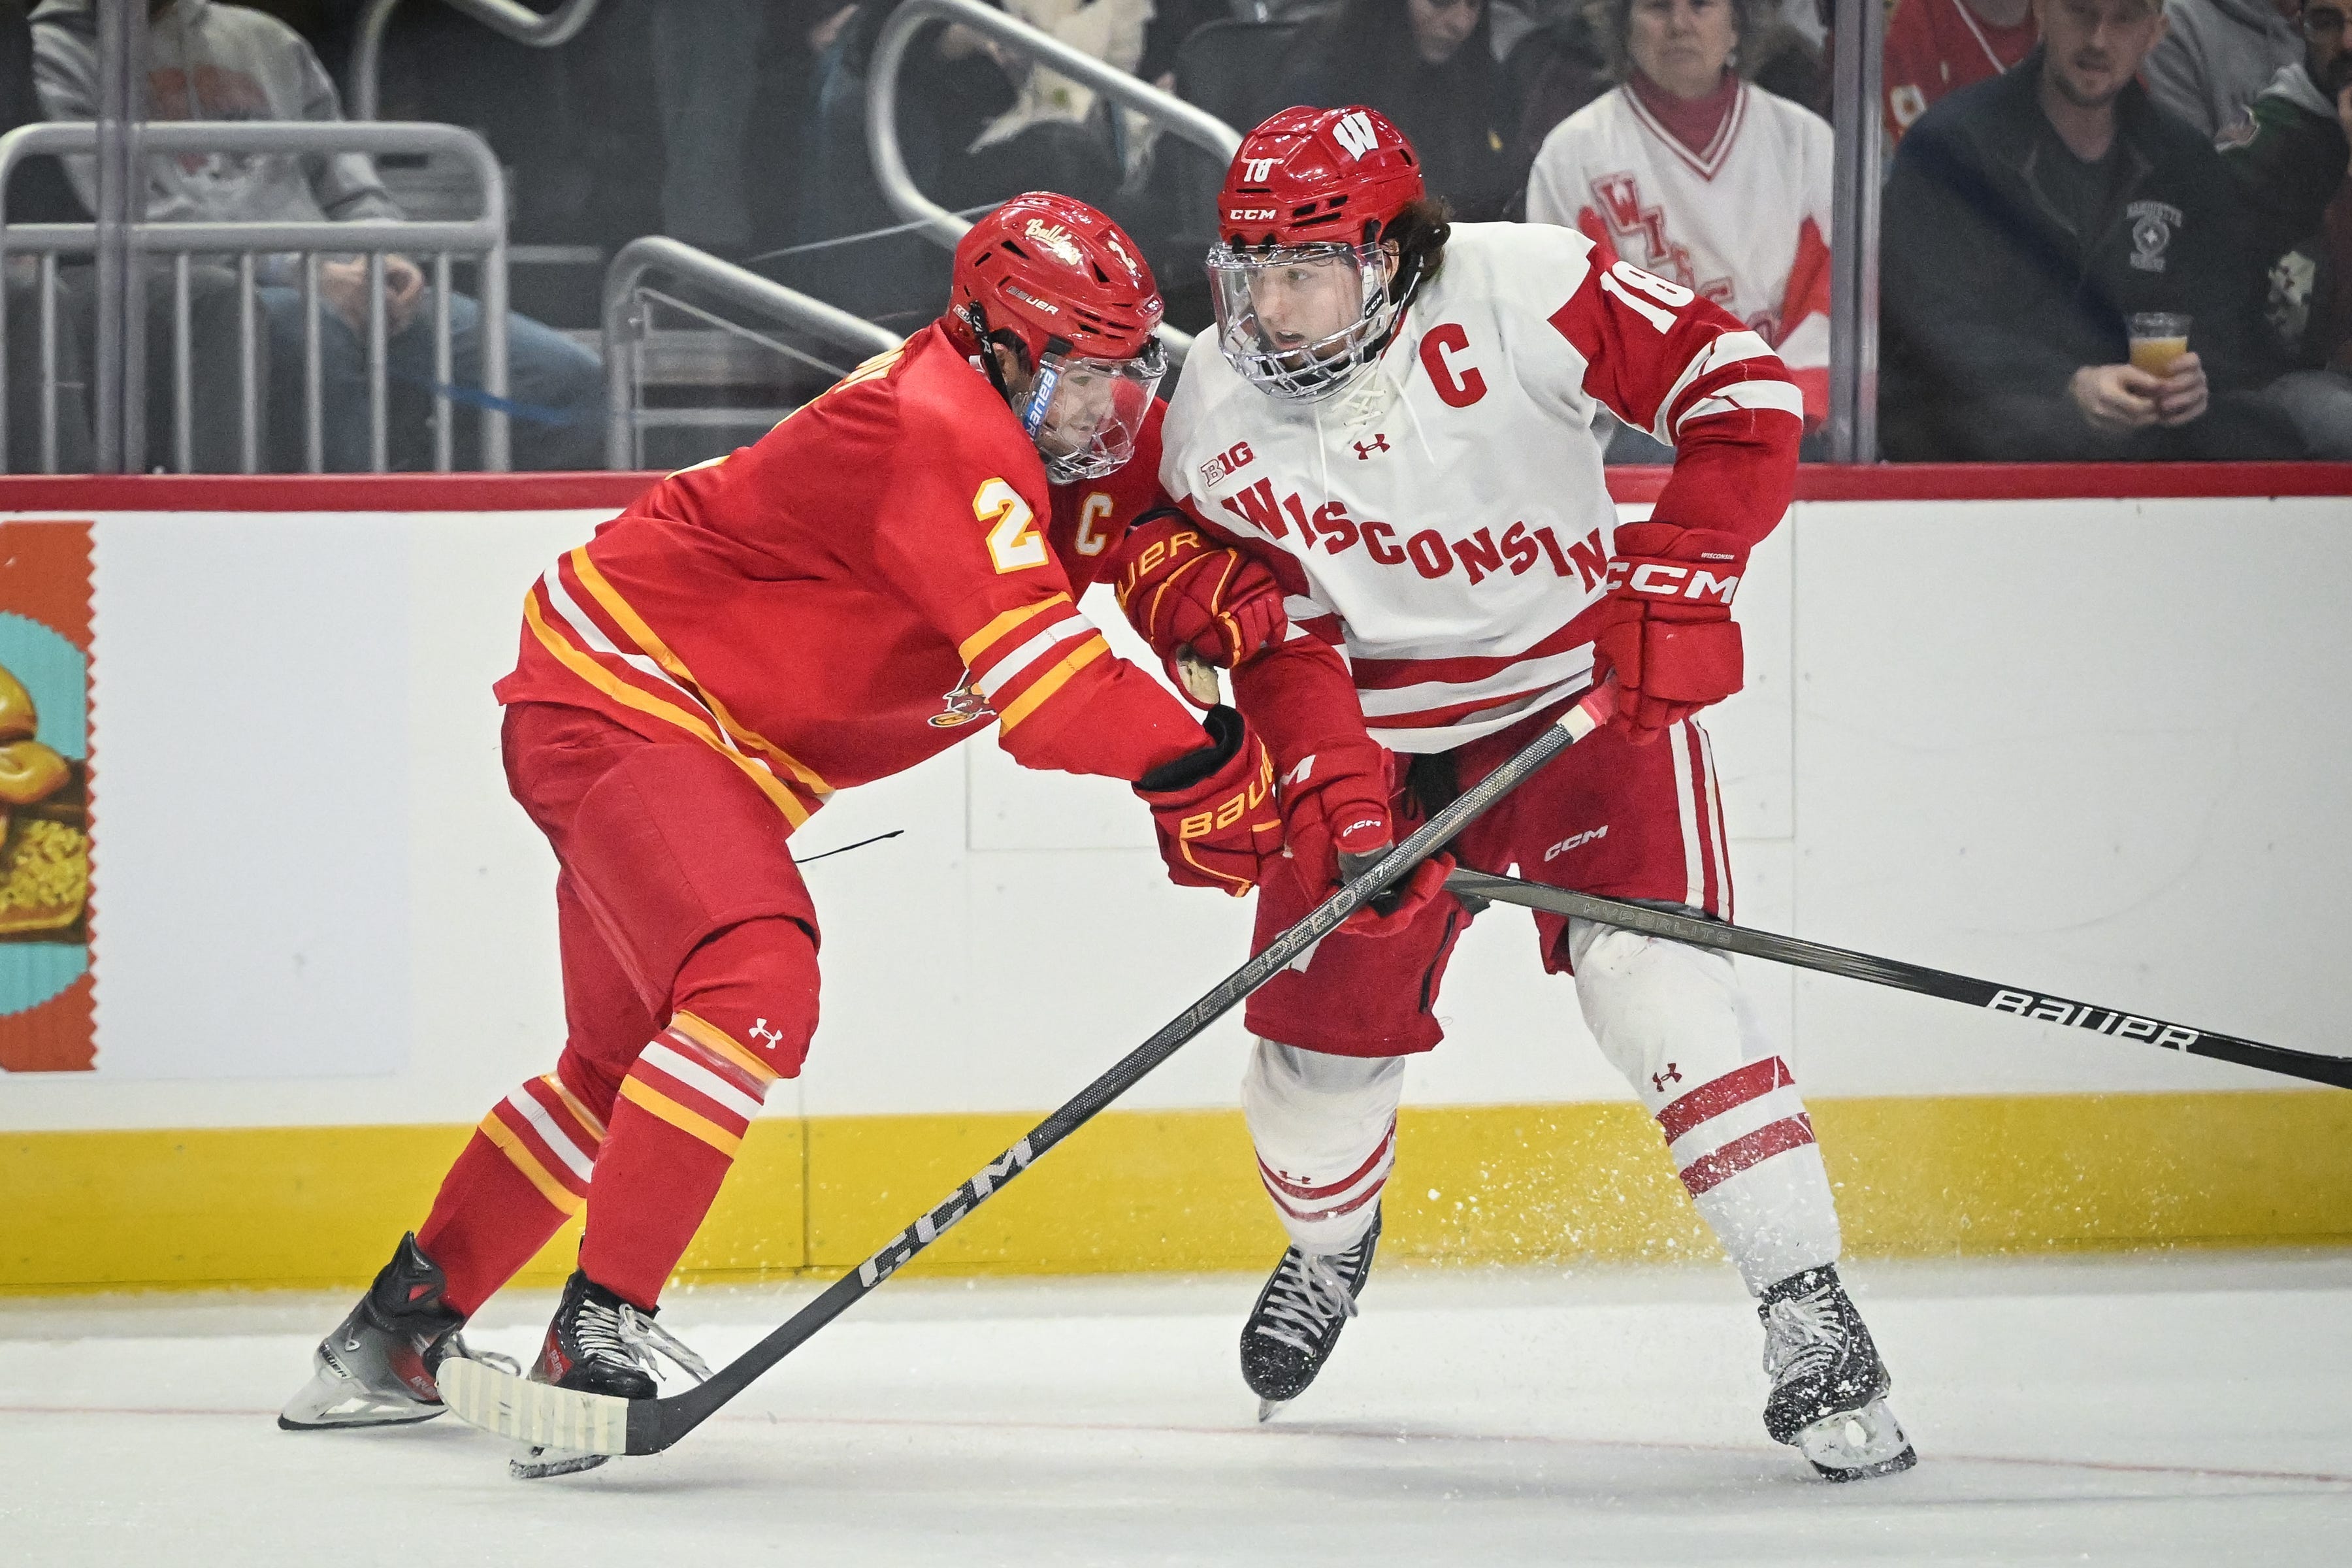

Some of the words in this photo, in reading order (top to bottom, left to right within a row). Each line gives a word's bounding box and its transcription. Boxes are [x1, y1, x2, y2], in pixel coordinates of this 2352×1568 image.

[1332, 112, 1379, 162] W
[1243, 157, 1271, 183] 18
[1230, 208, 1277, 220] CCM
[1108, 240, 1138, 271] 2
[1005, 286, 1059, 316] BAUER
[1365, 293, 1383, 316] CCM
[1599, 260, 1695, 335] 18
[1419, 323, 1488, 408] C
[1026, 368, 1055, 436] BAUER
[972, 477, 1049, 575] 2
[1075, 491, 1113, 556] C
[1221, 477, 1609, 595] WISCONSIN
[1607, 561, 1739, 604] CCM
[1343, 819, 1381, 838] CCM
[1544, 825, 1609, 862] CCM
[1985, 989, 2199, 1053] BAUER
[858, 1135, 1032, 1288] CCM
